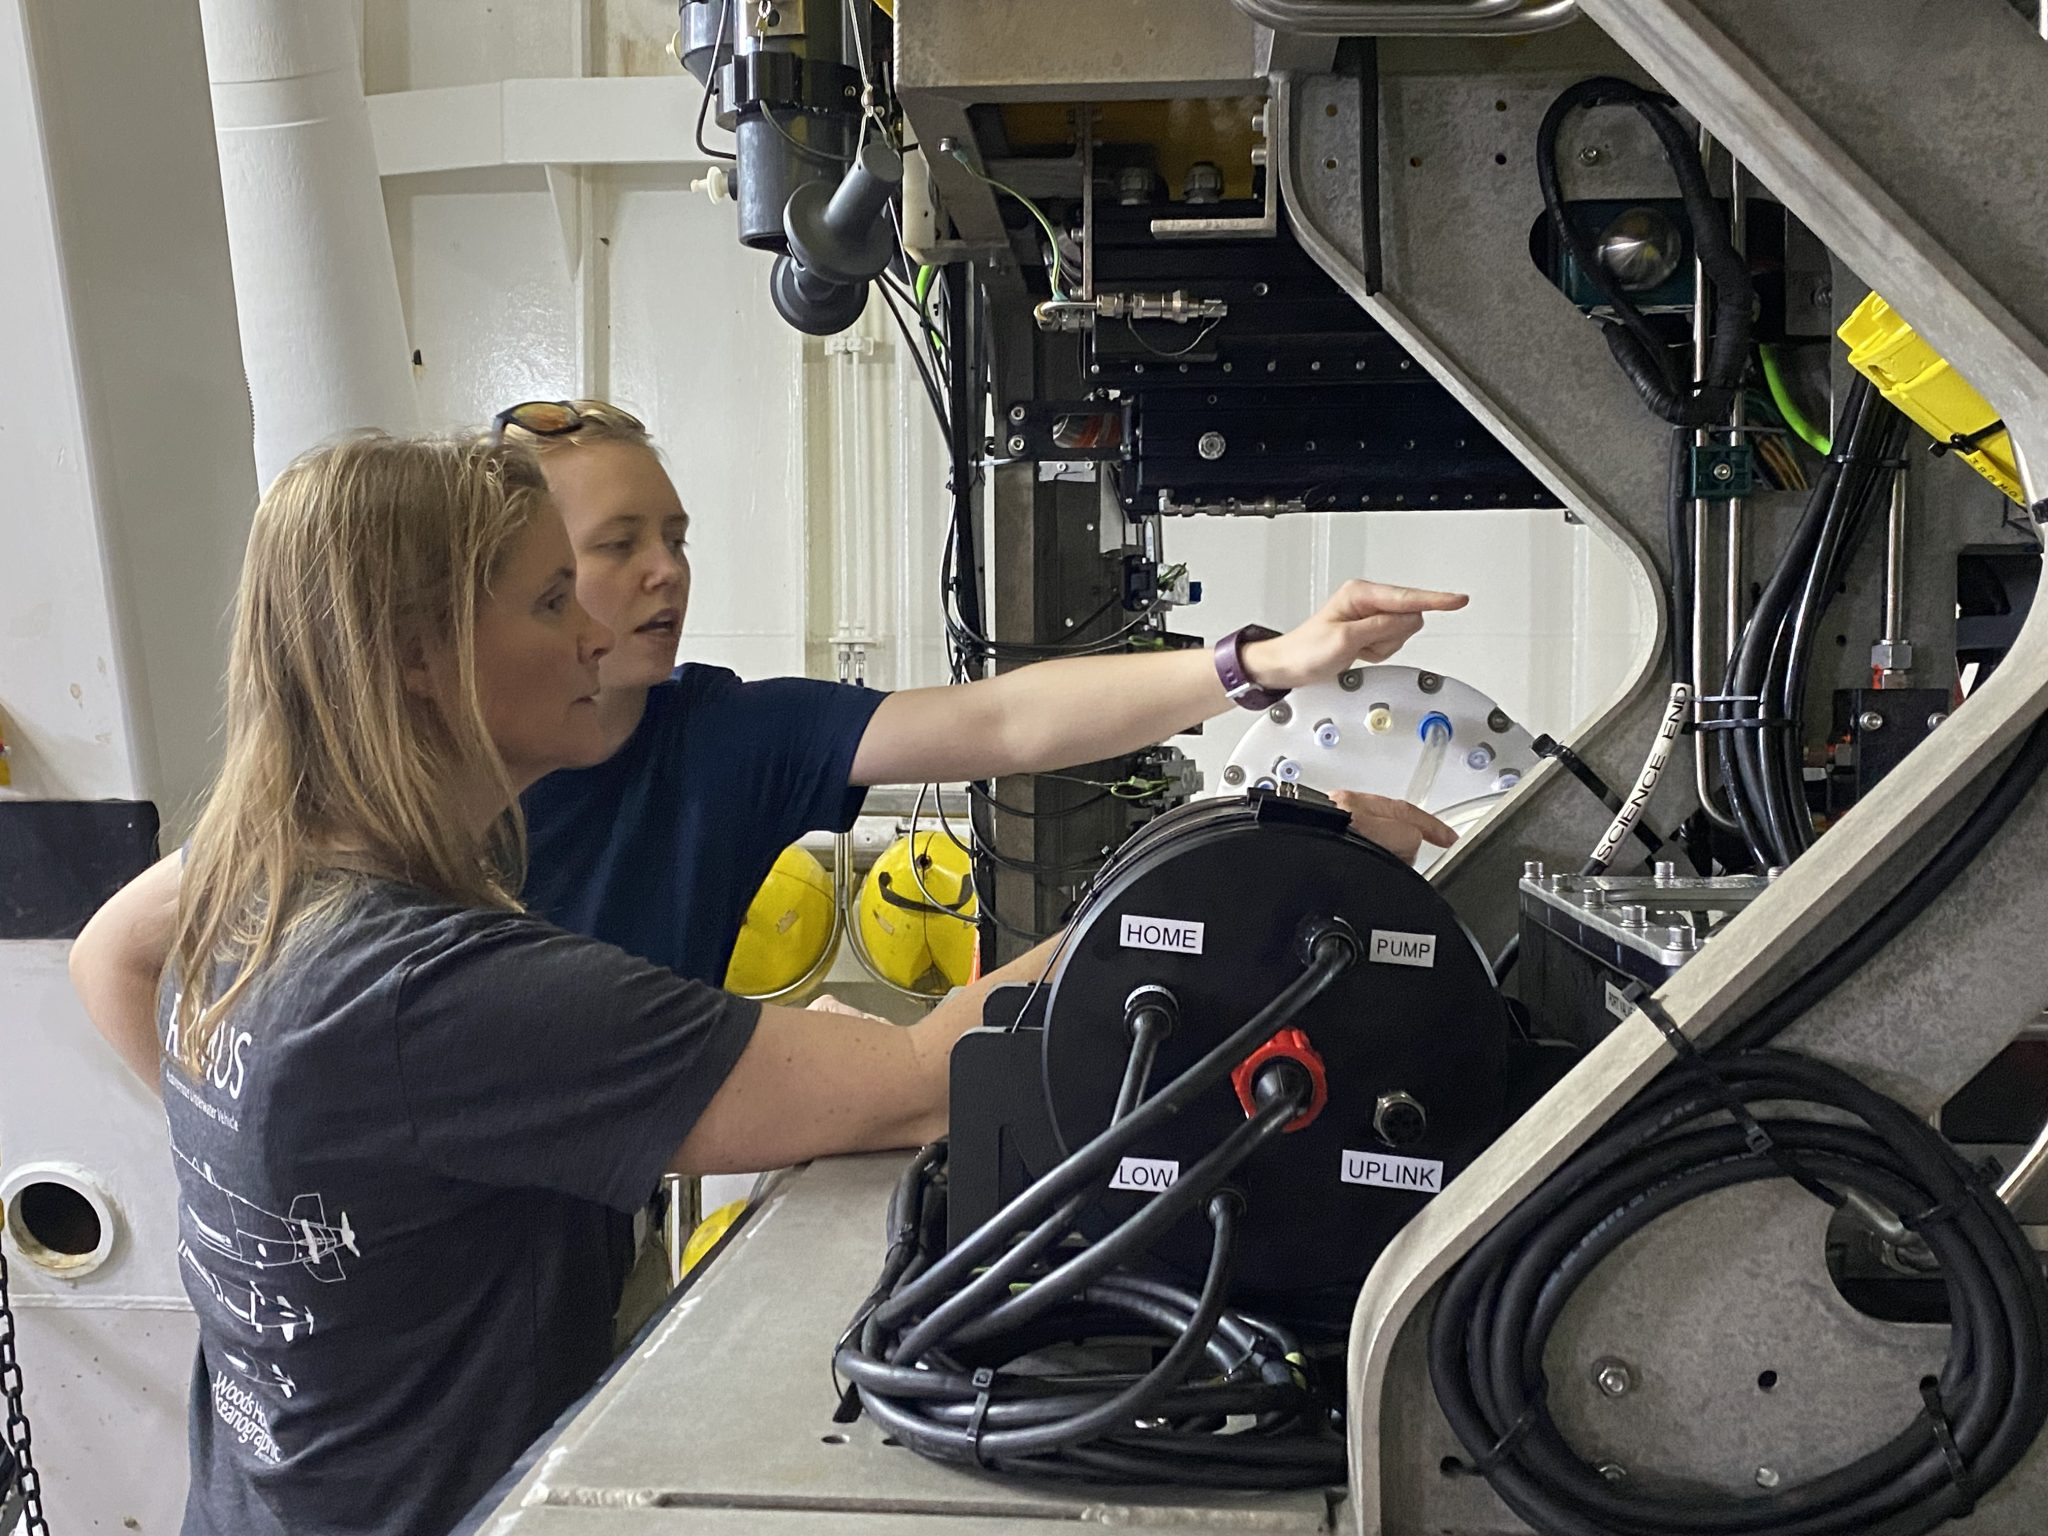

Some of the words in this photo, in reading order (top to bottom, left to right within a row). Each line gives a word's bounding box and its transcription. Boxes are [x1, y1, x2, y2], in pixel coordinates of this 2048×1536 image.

[1597, 752, 1666, 860] SCIENCE
[1663, 686, 1687, 740] END
[1127, 923, 1197, 949] HOME
[1377, 938, 1431, 959] PUMP
[1119, 1165, 1173, 1187] LOW
[1349, 1159, 1435, 1187] UPLINK
[215, 1370, 255, 1415] Woods
